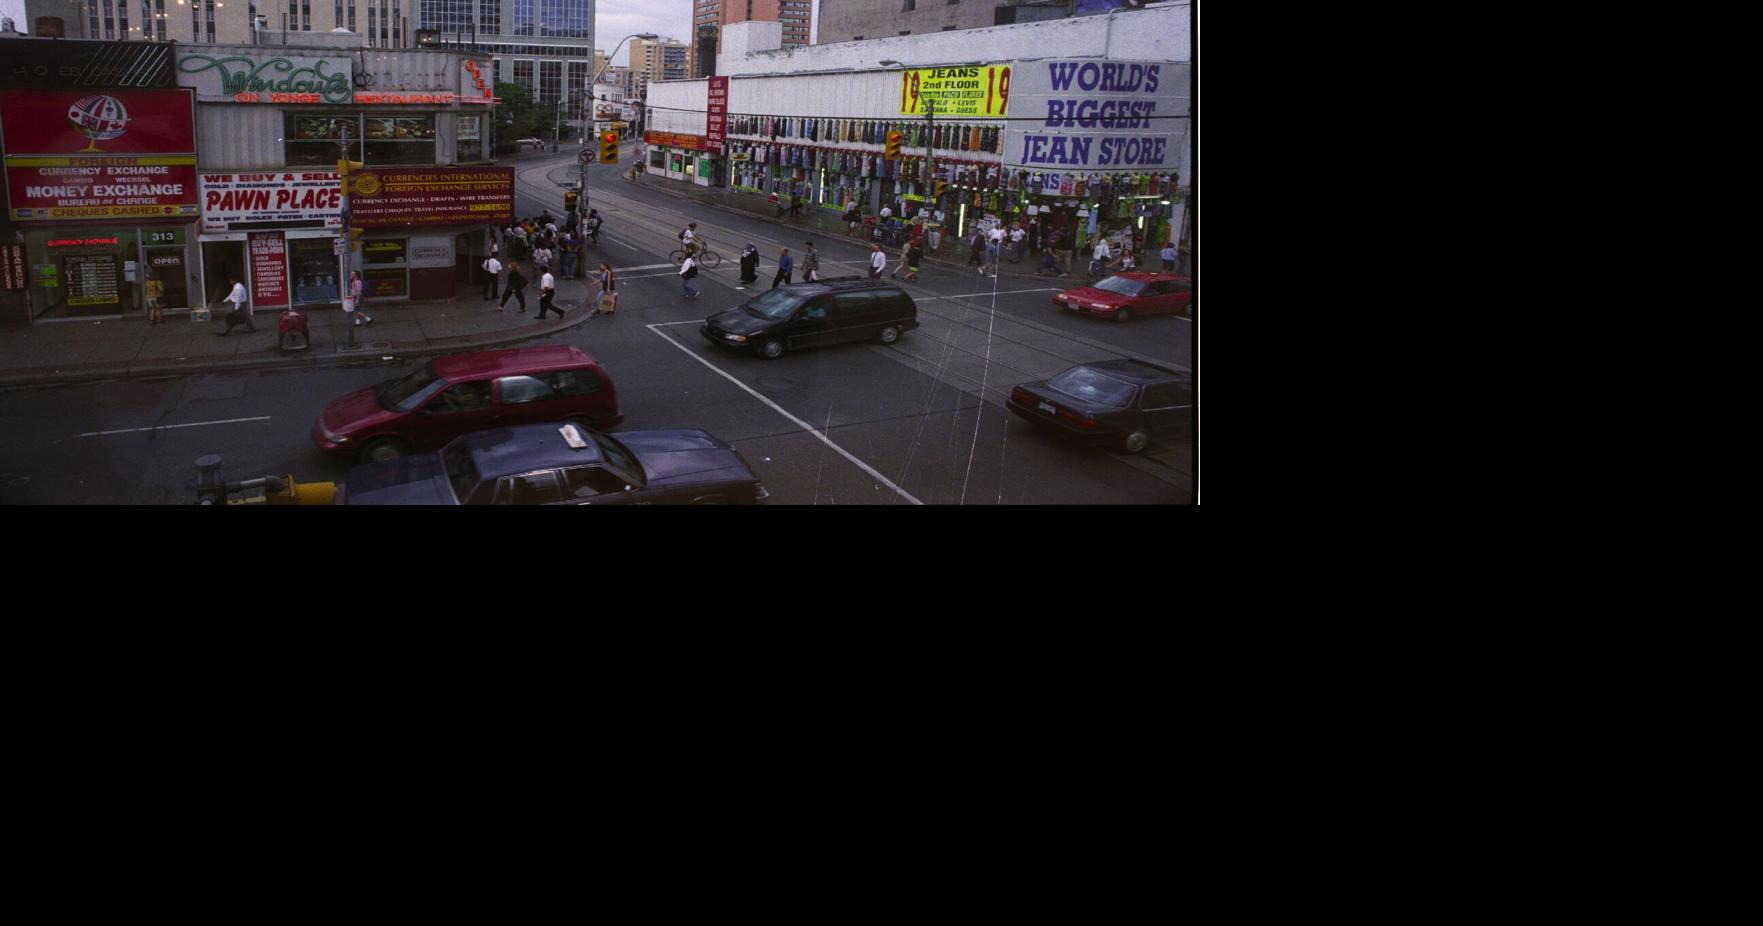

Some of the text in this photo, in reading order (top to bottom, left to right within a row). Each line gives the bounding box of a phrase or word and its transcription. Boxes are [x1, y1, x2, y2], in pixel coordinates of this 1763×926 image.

[178, 52, 351, 103] Windows
[928, 67, 979, 79] JEANS
[1048, 62, 1160, 93] WORLD'S
[923, 80, 980, 89] 2nd FLOOR
[986, 66, 1011, 115] 19
[232, 92, 321, 103] ON YONGE
[354, 92, 452, 104] RESTAURANT
[1045, 99, 1157, 129] BIGGEST
[1021, 135, 1167, 165] JEAN STORE
[69, 158, 138, 167] FOREIGN
[39, 165, 169, 176] CURRENCY EXCHANGE
[239, 174, 276, 182] BUY
[283, 173, 295, 181] &
[302, 172, 342, 180] SELL
[383, 173, 509, 182] CURRENCIES INTERNATIONAL
[26, 184, 183, 198] MONEY EXCHANGE
[425, 184, 471, 192] EXCHANGE
[472, 183, 510, 191] SERVICES
[58, 198, 100, 207] BUREAU
[116, 197, 158, 206] CHANGE
[206, 187, 341, 211] PAWN PLACE
[52, 206, 160, 217] CHEQUES CASHED
[152, 232, 175, 241] 313
[153, 257, 180, 265] OPEN
